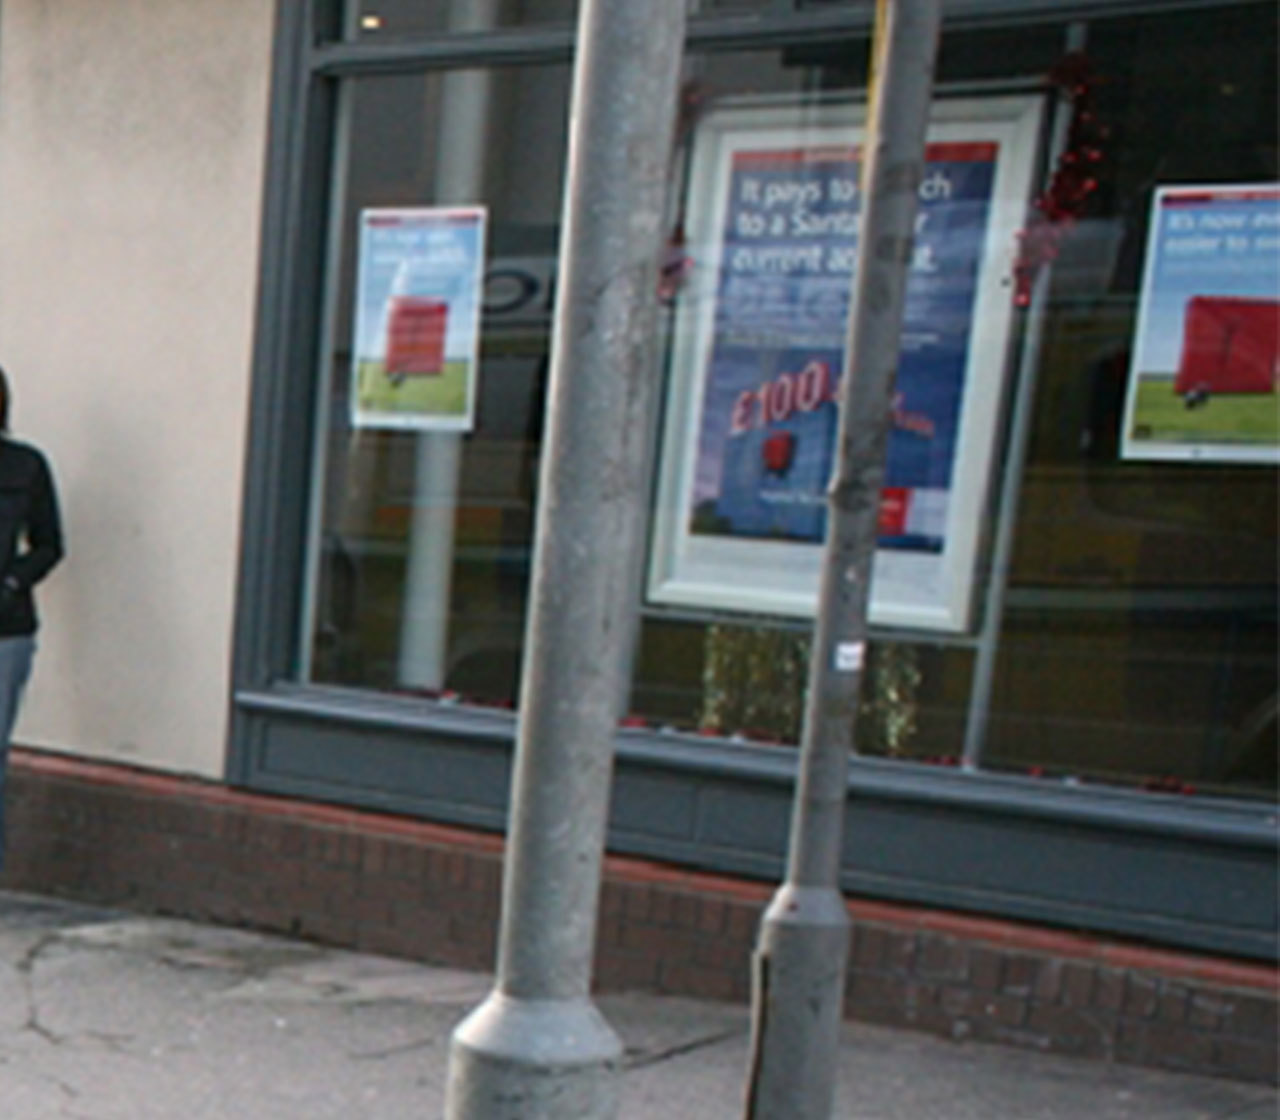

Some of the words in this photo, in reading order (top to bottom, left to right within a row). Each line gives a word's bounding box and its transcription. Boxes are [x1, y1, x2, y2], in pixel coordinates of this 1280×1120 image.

[740, 178, 760, 201] It
[766, 180, 822, 206] pays
[829, 177, 857, 201] to
[737, 211, 766, 236] to
[769, 216, 787, 236] a
[732, 246, 823, 273] current
[729, 361, 828, 437] £100
